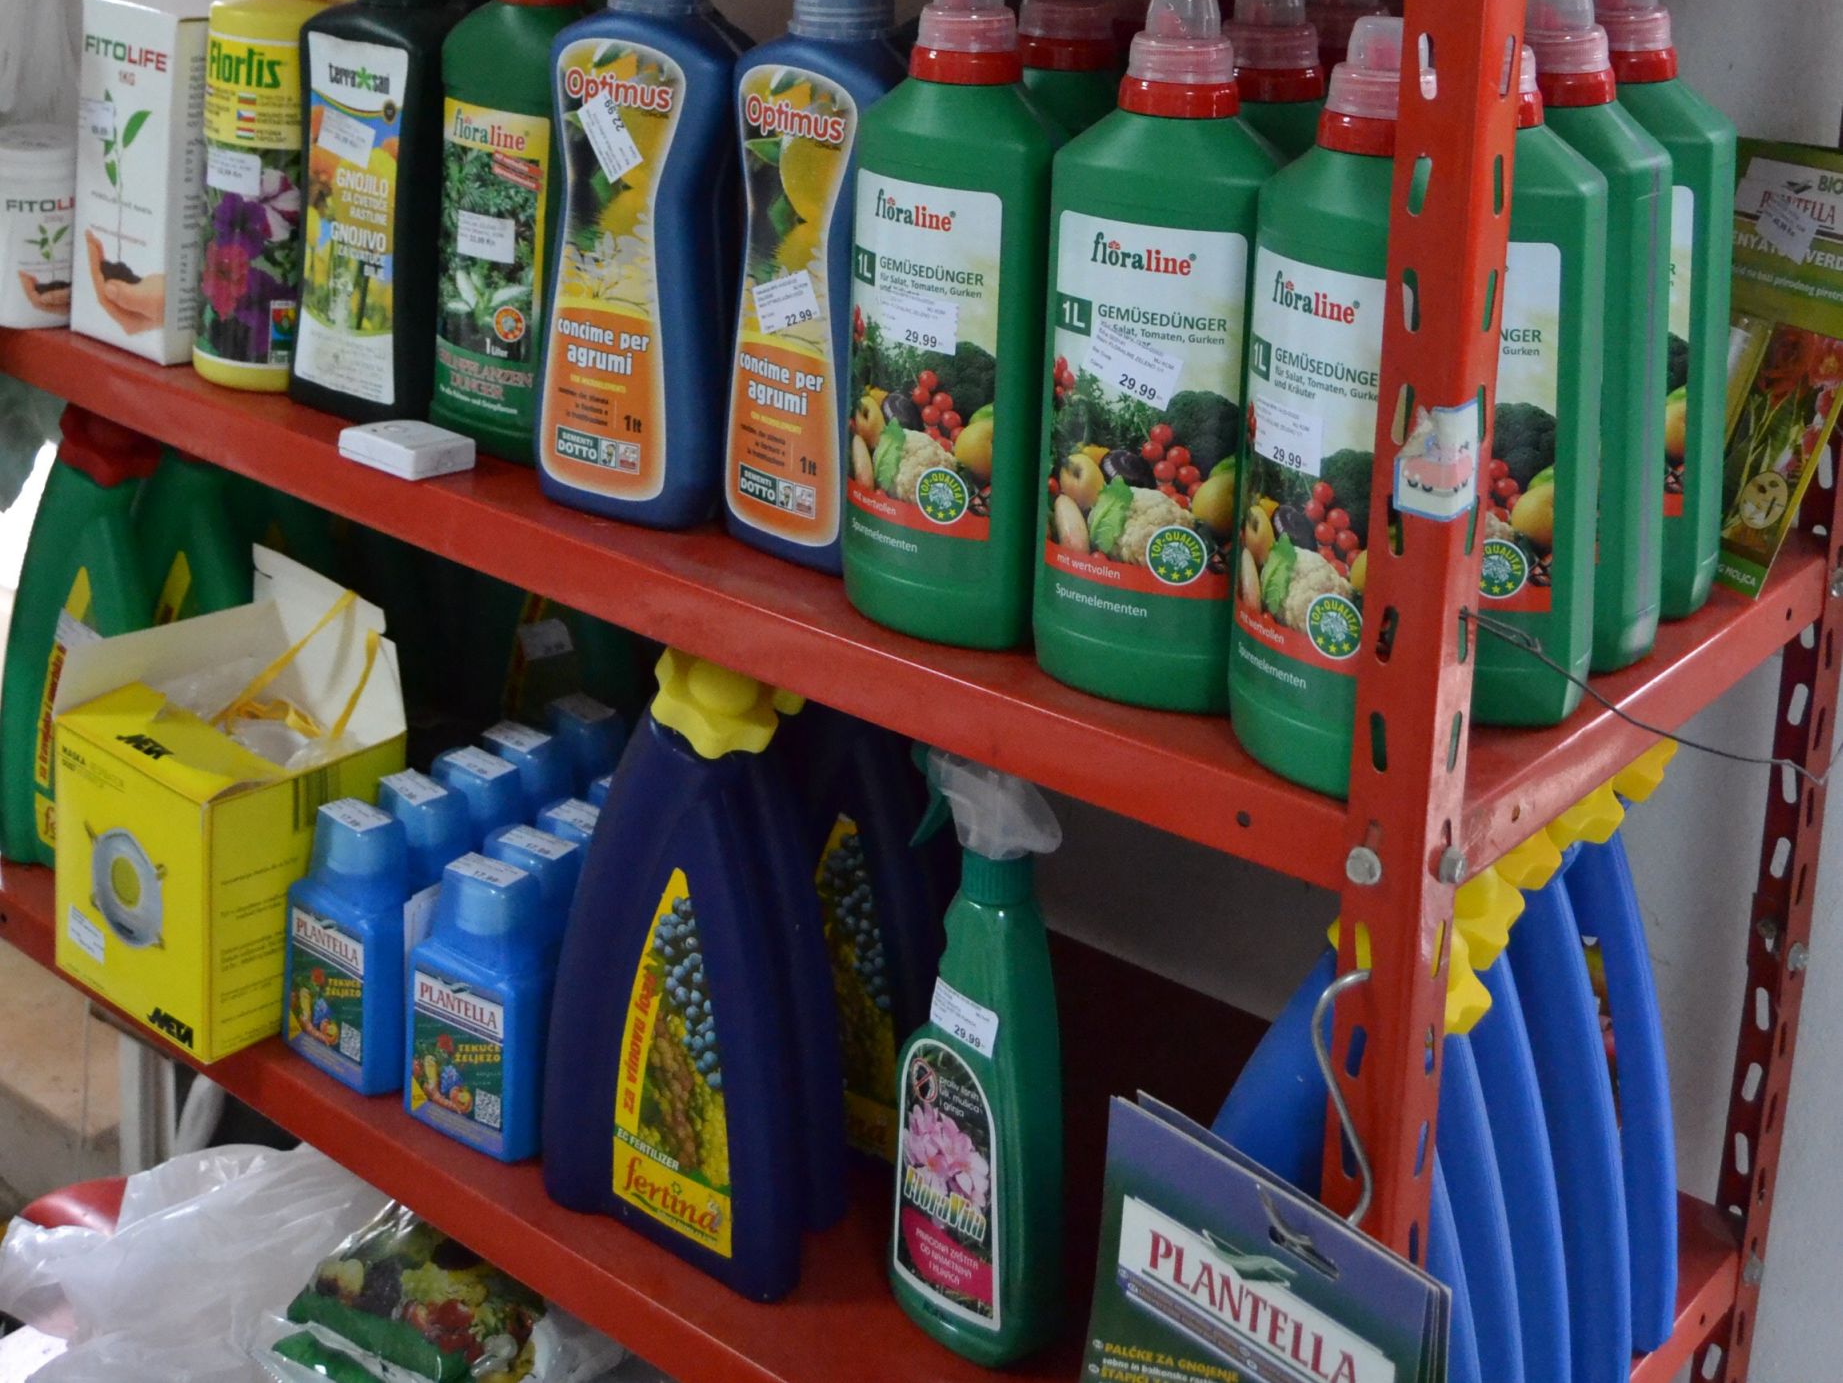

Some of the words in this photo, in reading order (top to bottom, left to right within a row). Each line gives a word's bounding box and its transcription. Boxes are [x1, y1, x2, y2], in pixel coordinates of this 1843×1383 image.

[84, 33, 168, 73] FITOLIFE
[209, 38, 283, 89] Flortis
[567, 68, 672, 112] Optimus
[453, 107, 526, 151] floraline
[604, 98, 625, 133] 22.99
[745, 94, 844, 143] Optimus
[336, 167, 388, 197] GNOJILO
[875, 188, 952, 232] floraline
[330, 221, 386, 253] GNOJIVO
[857, 253, 872, 278] 1L
[1091, 231, 1192, 276] floraline
[880, 256, 985, 287] GEMÜSEDÜNGER
[890, 276, 909, 288] Salat,
[911, 279, 947, 296] Tomaten,
[950, 286, 982, 299] Gurken
[1272, 270, 1355, 324] floraline
[785, 309, 813, 327] 22.99
[1062, 300, 1086, 328] 1L
[1098, 304, 1227, 332] GEMÜSEDÜNGER
[557, 318, 614, 346] concime
[619, 329, 650, 352] per
[905, 328, 937, 348] 29.99
[1140, 328, 1186, 344] Tomaten,
[1188, 334, 1225, 346] Gurken
[567, 343, 633, 375] agrumi
[1254, 342, 1268, 373] 1L
[1503, 346, 1540, 357] Gurken
[739, 352, 790, 383] concime
[796, 370, 824, 392] per
[1119, 373, 1156, 401] 29.99
[1285, 369, 1306, 385] Salat,
[1307, 378, 1347, 397] Tomaten,
[747, 380, 808, 416] agrumi
[1274, 379, 1286, 390] und
[1287, 384, 1316, 400] Kräuter
[557, 440, 598, 460] DOTTO
[562, 432, 594, 447] SEMENTI
[1273, 446, 1301, 469] 29.99
[740, 477, 776, 502] DOTTO
[862, 492, 897, 516] wertvollen
[852, 517, 918, 554] Spurenelementen
[1057, 553, 1070, 566] mit
[1071, 558, 1121, 580] wertvollen
[1055, 582, 1148, 618] Spurenelementen
[1238, 642, 1307, 689] Spurenelementen
[296, 917, 360, 967] PLANTELLA
[420, 981, 498, 1030] PLANTELLA
[626, 1018, 646, 1086] vinovu
[954, 1024, 980, 1049] 29.99
[616, 1126, 629, 1143] EC
[628, 1135, 680, 1172] FERTILIZER
[625, 1156, 719, 1235] fertina
[1149, 1228, 1357, 1383] PLANTELLA
[1155, 1353, 1174, 1367] ZA
[1177, 1358, 1239, 1383] GNOJENJE
